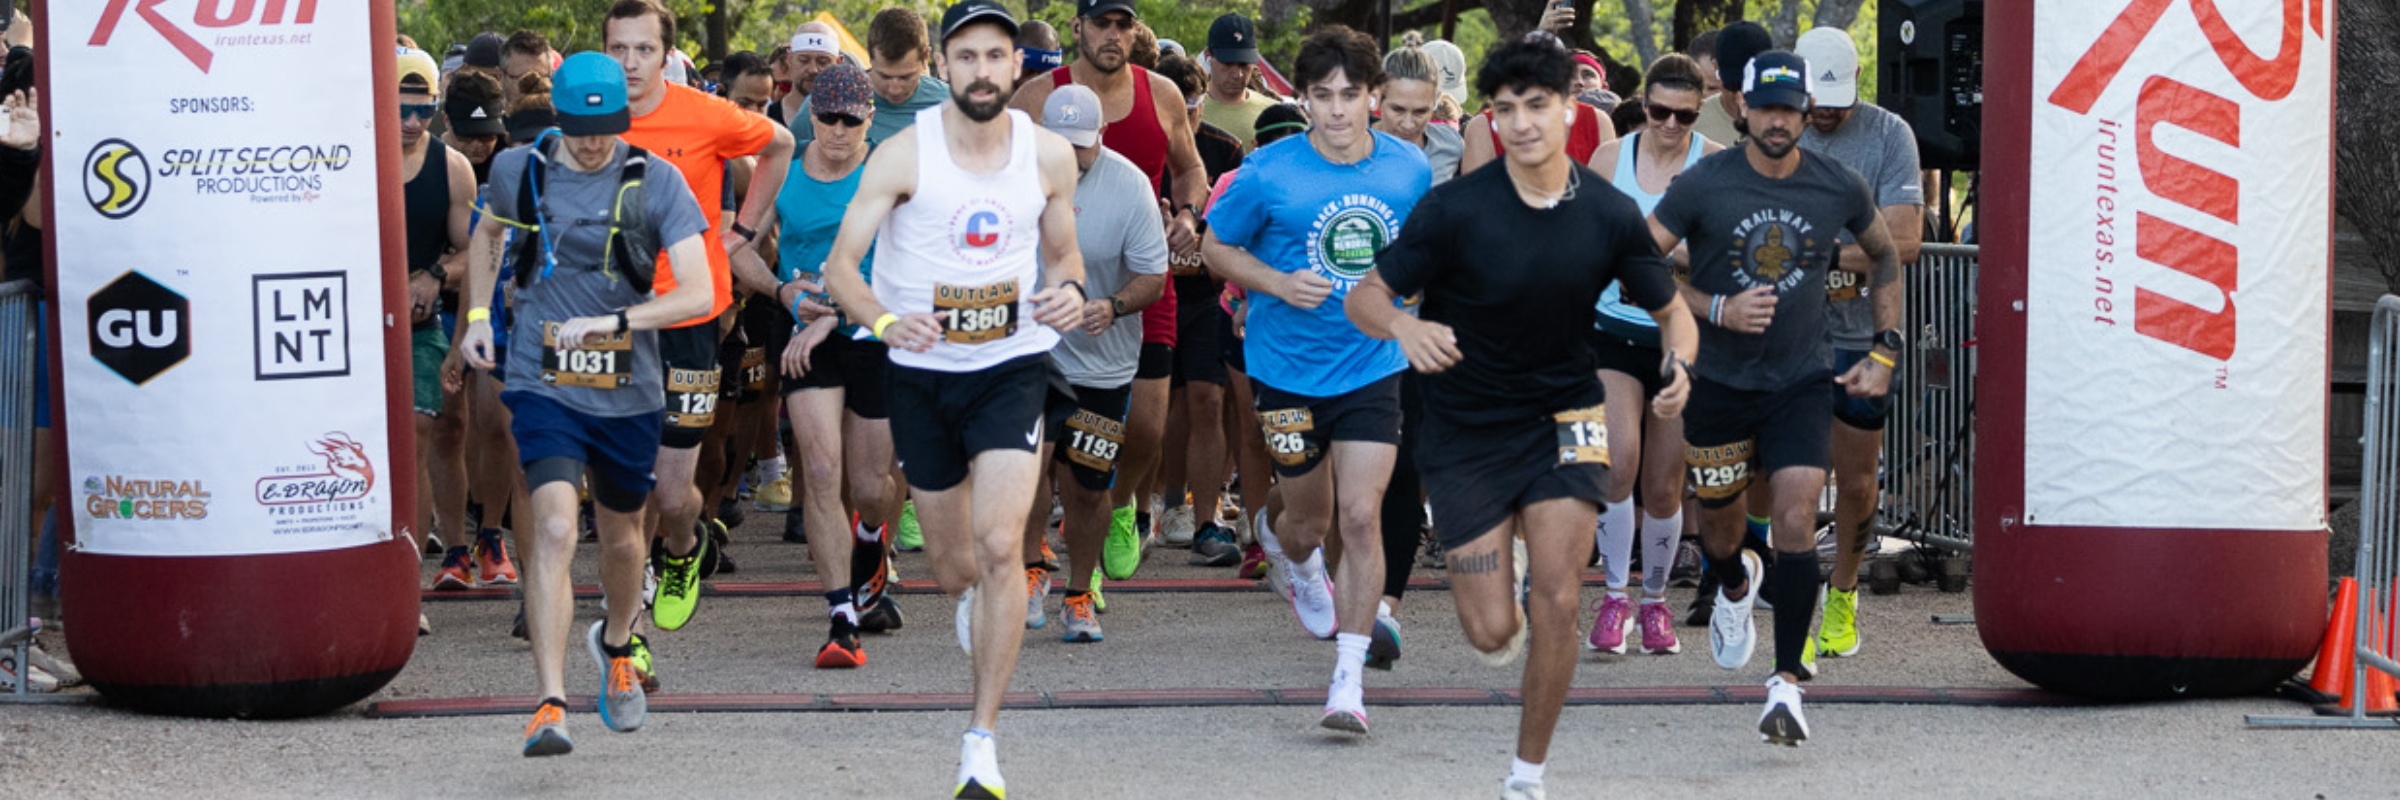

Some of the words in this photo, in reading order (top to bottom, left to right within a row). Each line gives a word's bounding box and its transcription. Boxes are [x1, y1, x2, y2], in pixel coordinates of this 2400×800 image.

[214, 32, 312, 47] iruntexas.net
[169, 96, 255, 114] SPONSORS:
[158, 148, 234, 177] SPLIT
[232, 144, 351, 176] SECOND
[196, 174, 322, 195] PRODUCTIONS
[2094, 117, 2123, 327] iruntexas.net
[940, 280, 1015, 300] OUTLAW
[96, 308, 178, 349] GU
[945, 304, 1009, 332] 1360
[556, 350, 616, 374] 1031
[1071, 430, 1119, 461] 1193
[1692, 461, 1749, 487] 1292
[105, 475, 210, 498] NATURAL
[268, 500, 365, 516] PRODUCTIONS
